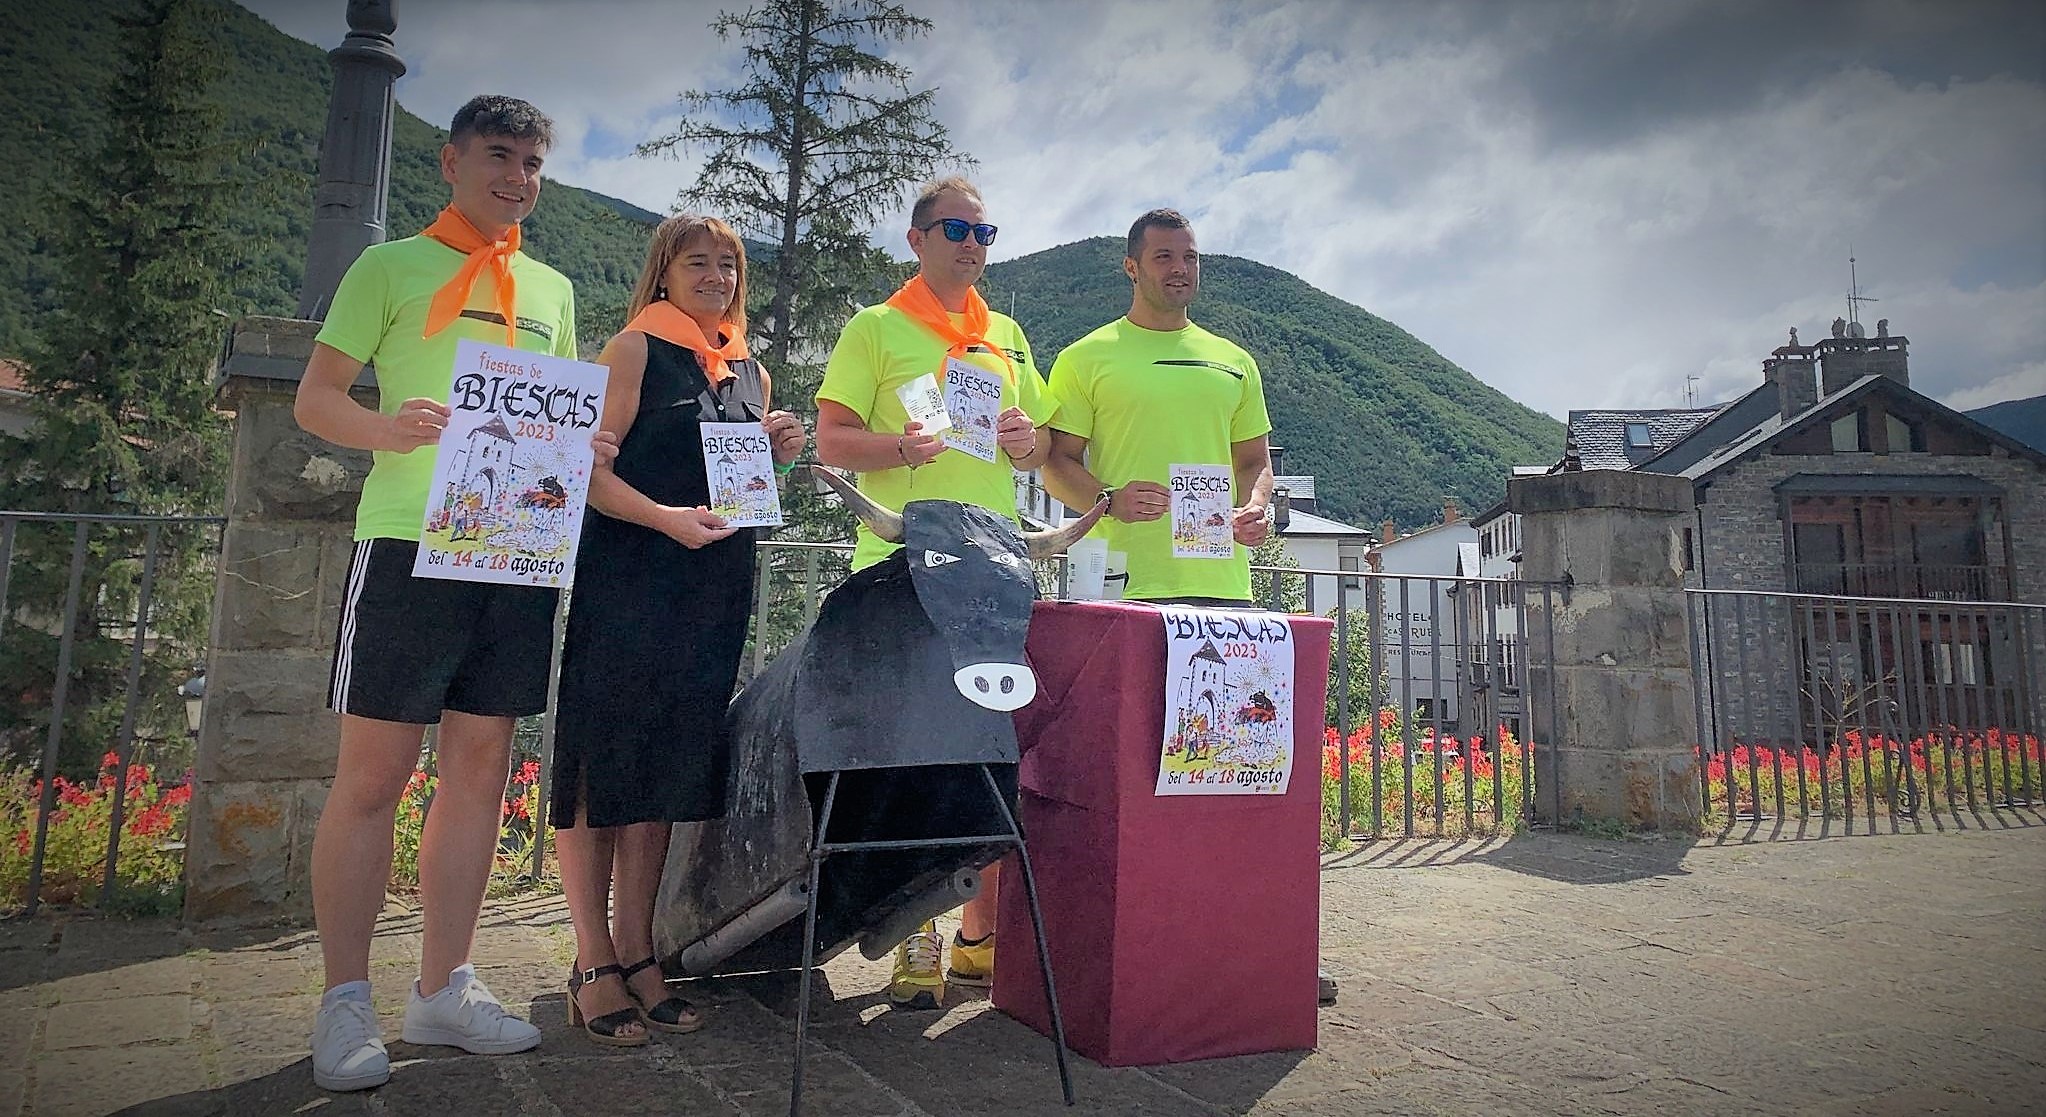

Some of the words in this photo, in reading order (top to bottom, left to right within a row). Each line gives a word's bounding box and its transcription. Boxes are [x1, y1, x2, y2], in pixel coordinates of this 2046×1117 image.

[479, 351, 524, 376] fiestas
[529, 364, 543, 378] de
[946, 369, 1001, 399] BIESCAS
[453, 373, 598, 429] BIESCAS
[514, 420, 556, 442] 2023
[704, 434, 768, 454] BIESCAS
[1171, 475, 1231, 492] BIESCAS
[428, 549, 446, 566] del
[452, 552, 473, 568] 14
[475, 555, 488, 569] al
[488, 553, 509, 570] 18
[511, 556, 565, 576] agosto
[1387, 612, 1428, 621] HOEL
[1223, 643, 1258, 659] 2023
[1168, 770, 1185, 785] del
[1187, 769, 1205, 784] 14
[1206, 772, 1217, 785] al
[1218, 768, 1235, 784] 18
[1237, 767, 1283, 787] agosto
